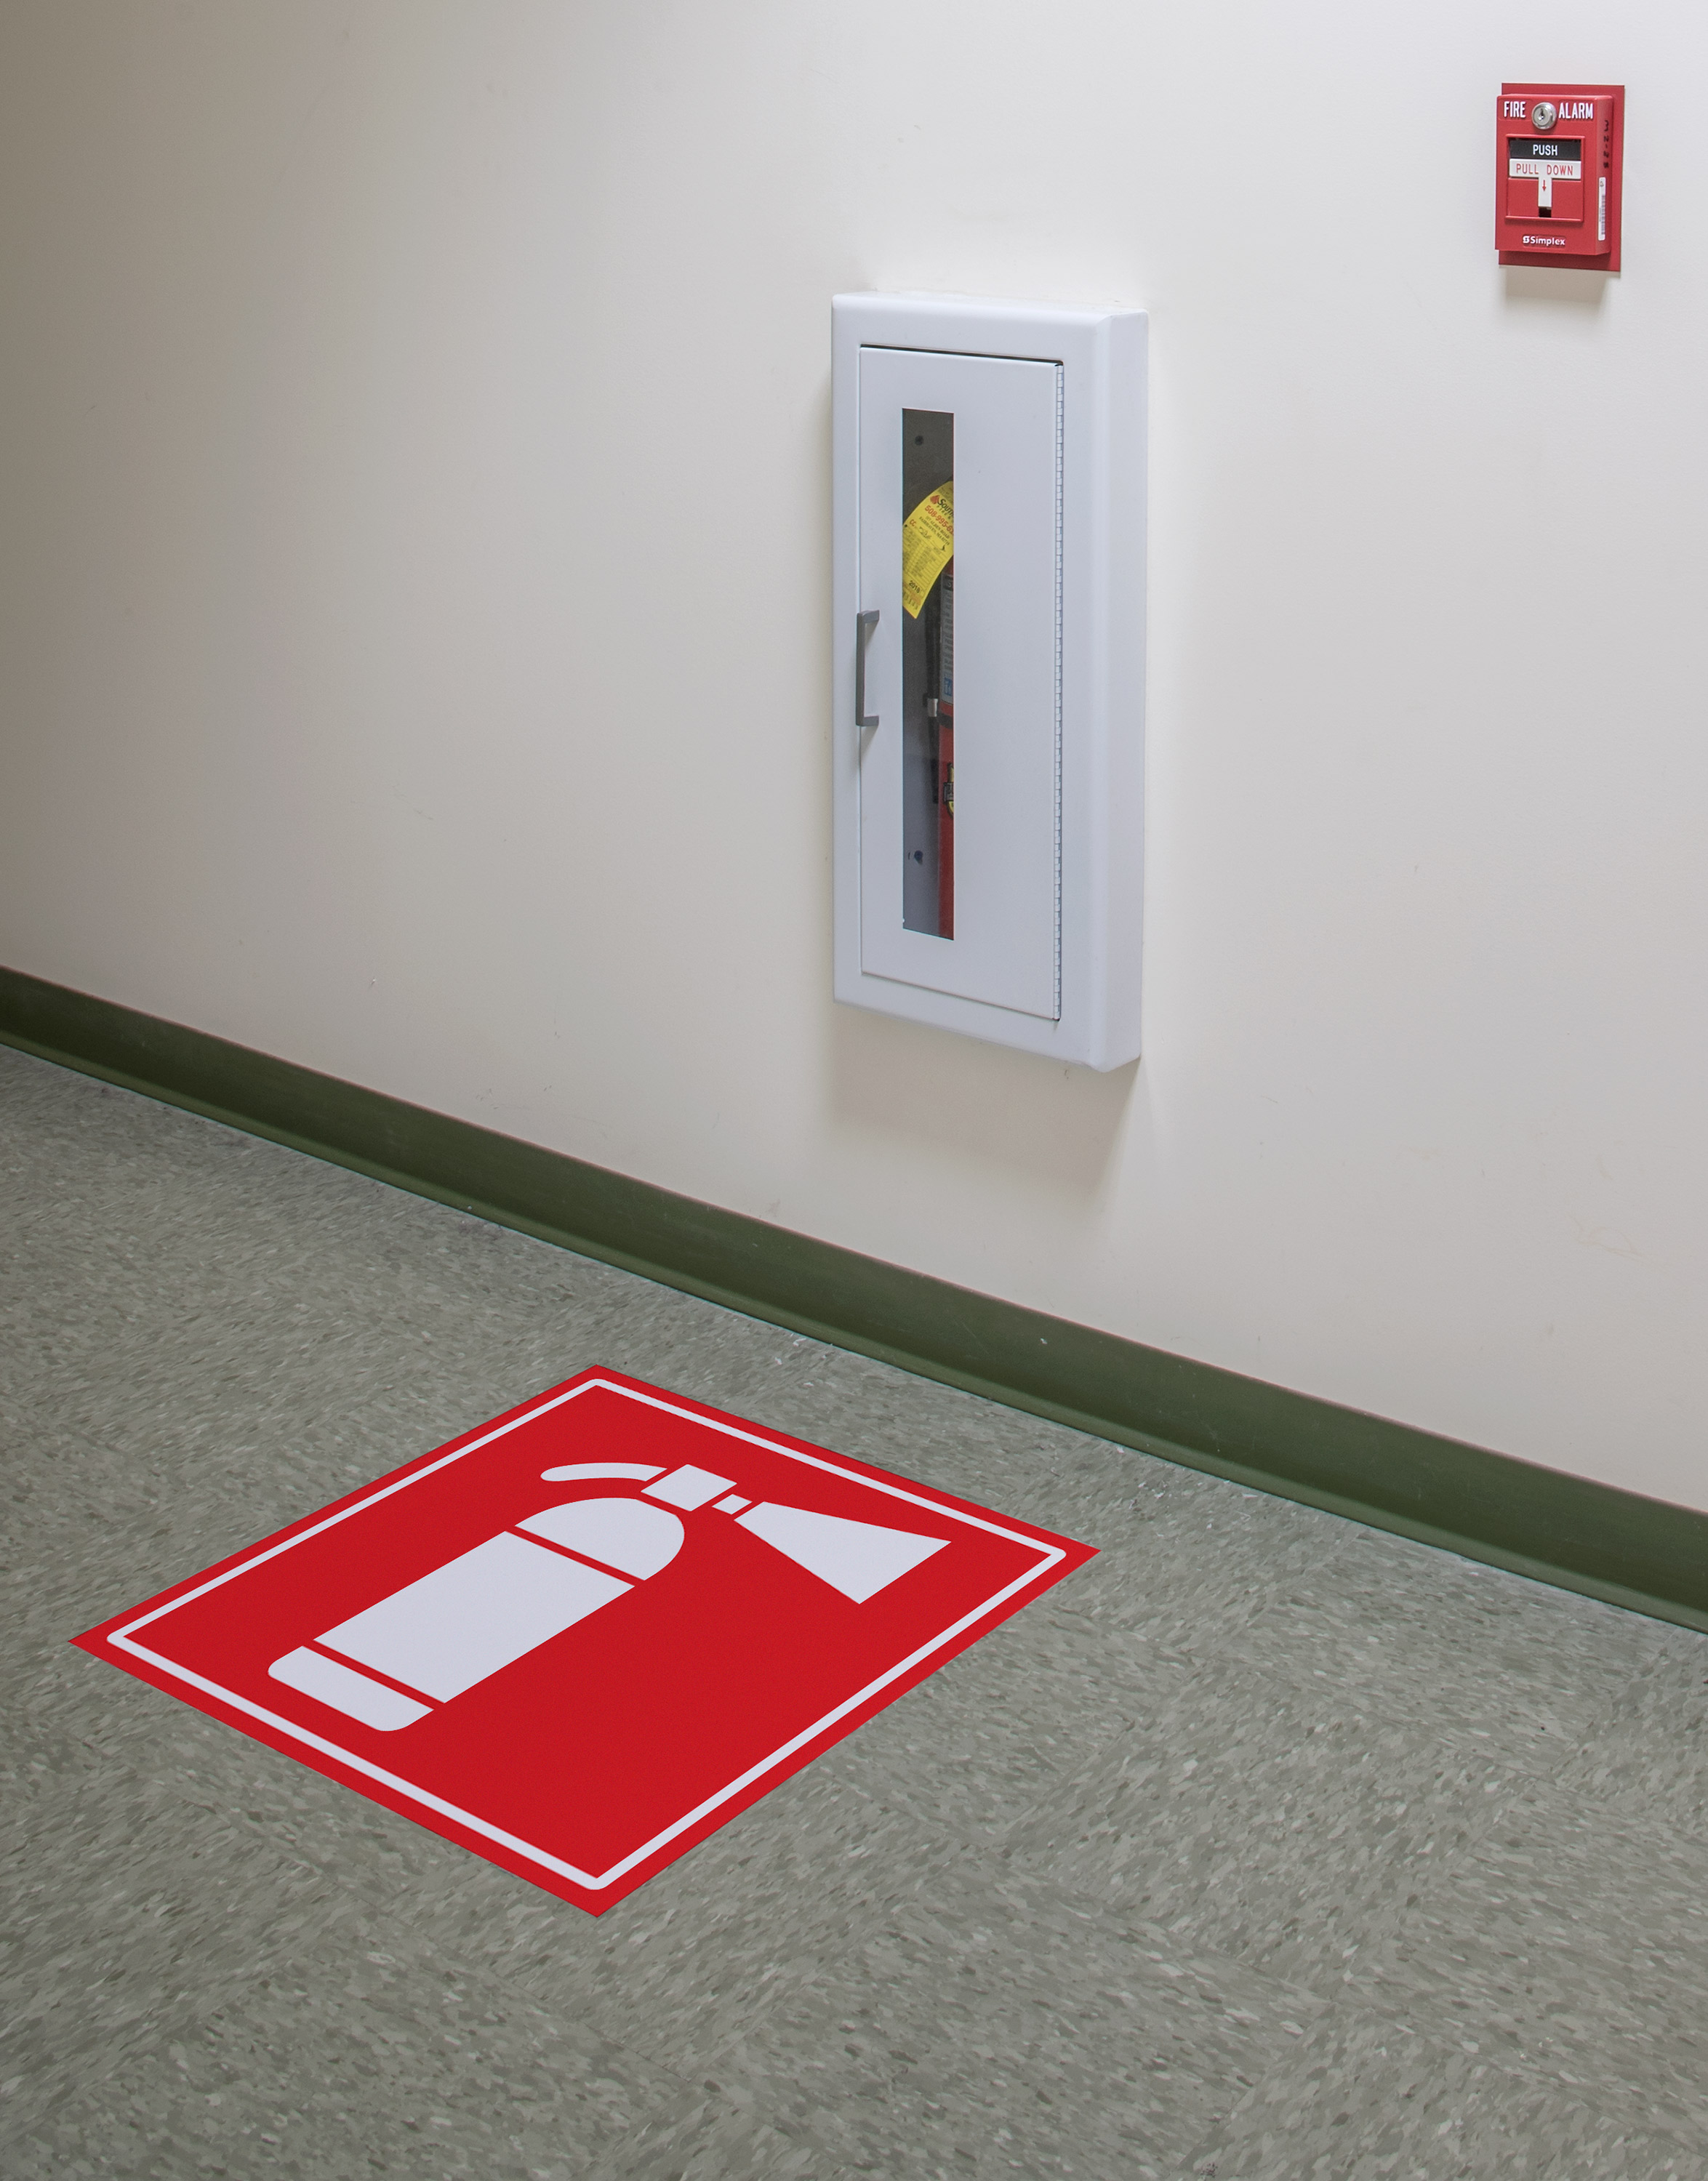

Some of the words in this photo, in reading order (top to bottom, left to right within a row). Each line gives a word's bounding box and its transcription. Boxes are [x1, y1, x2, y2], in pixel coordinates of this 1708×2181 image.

[1504, 101, 1526, 118] FIRE
[1558, 103, 1594, 119] ALARM
[1533, 144, 1558, 156] PUSH
[1516, 164, 1539, 174] PULL
[1547, 164, 1573, 175] DOWN
[1530, 236, 1565, 246] Simplex
[909, 580, 921, 593] 2018
